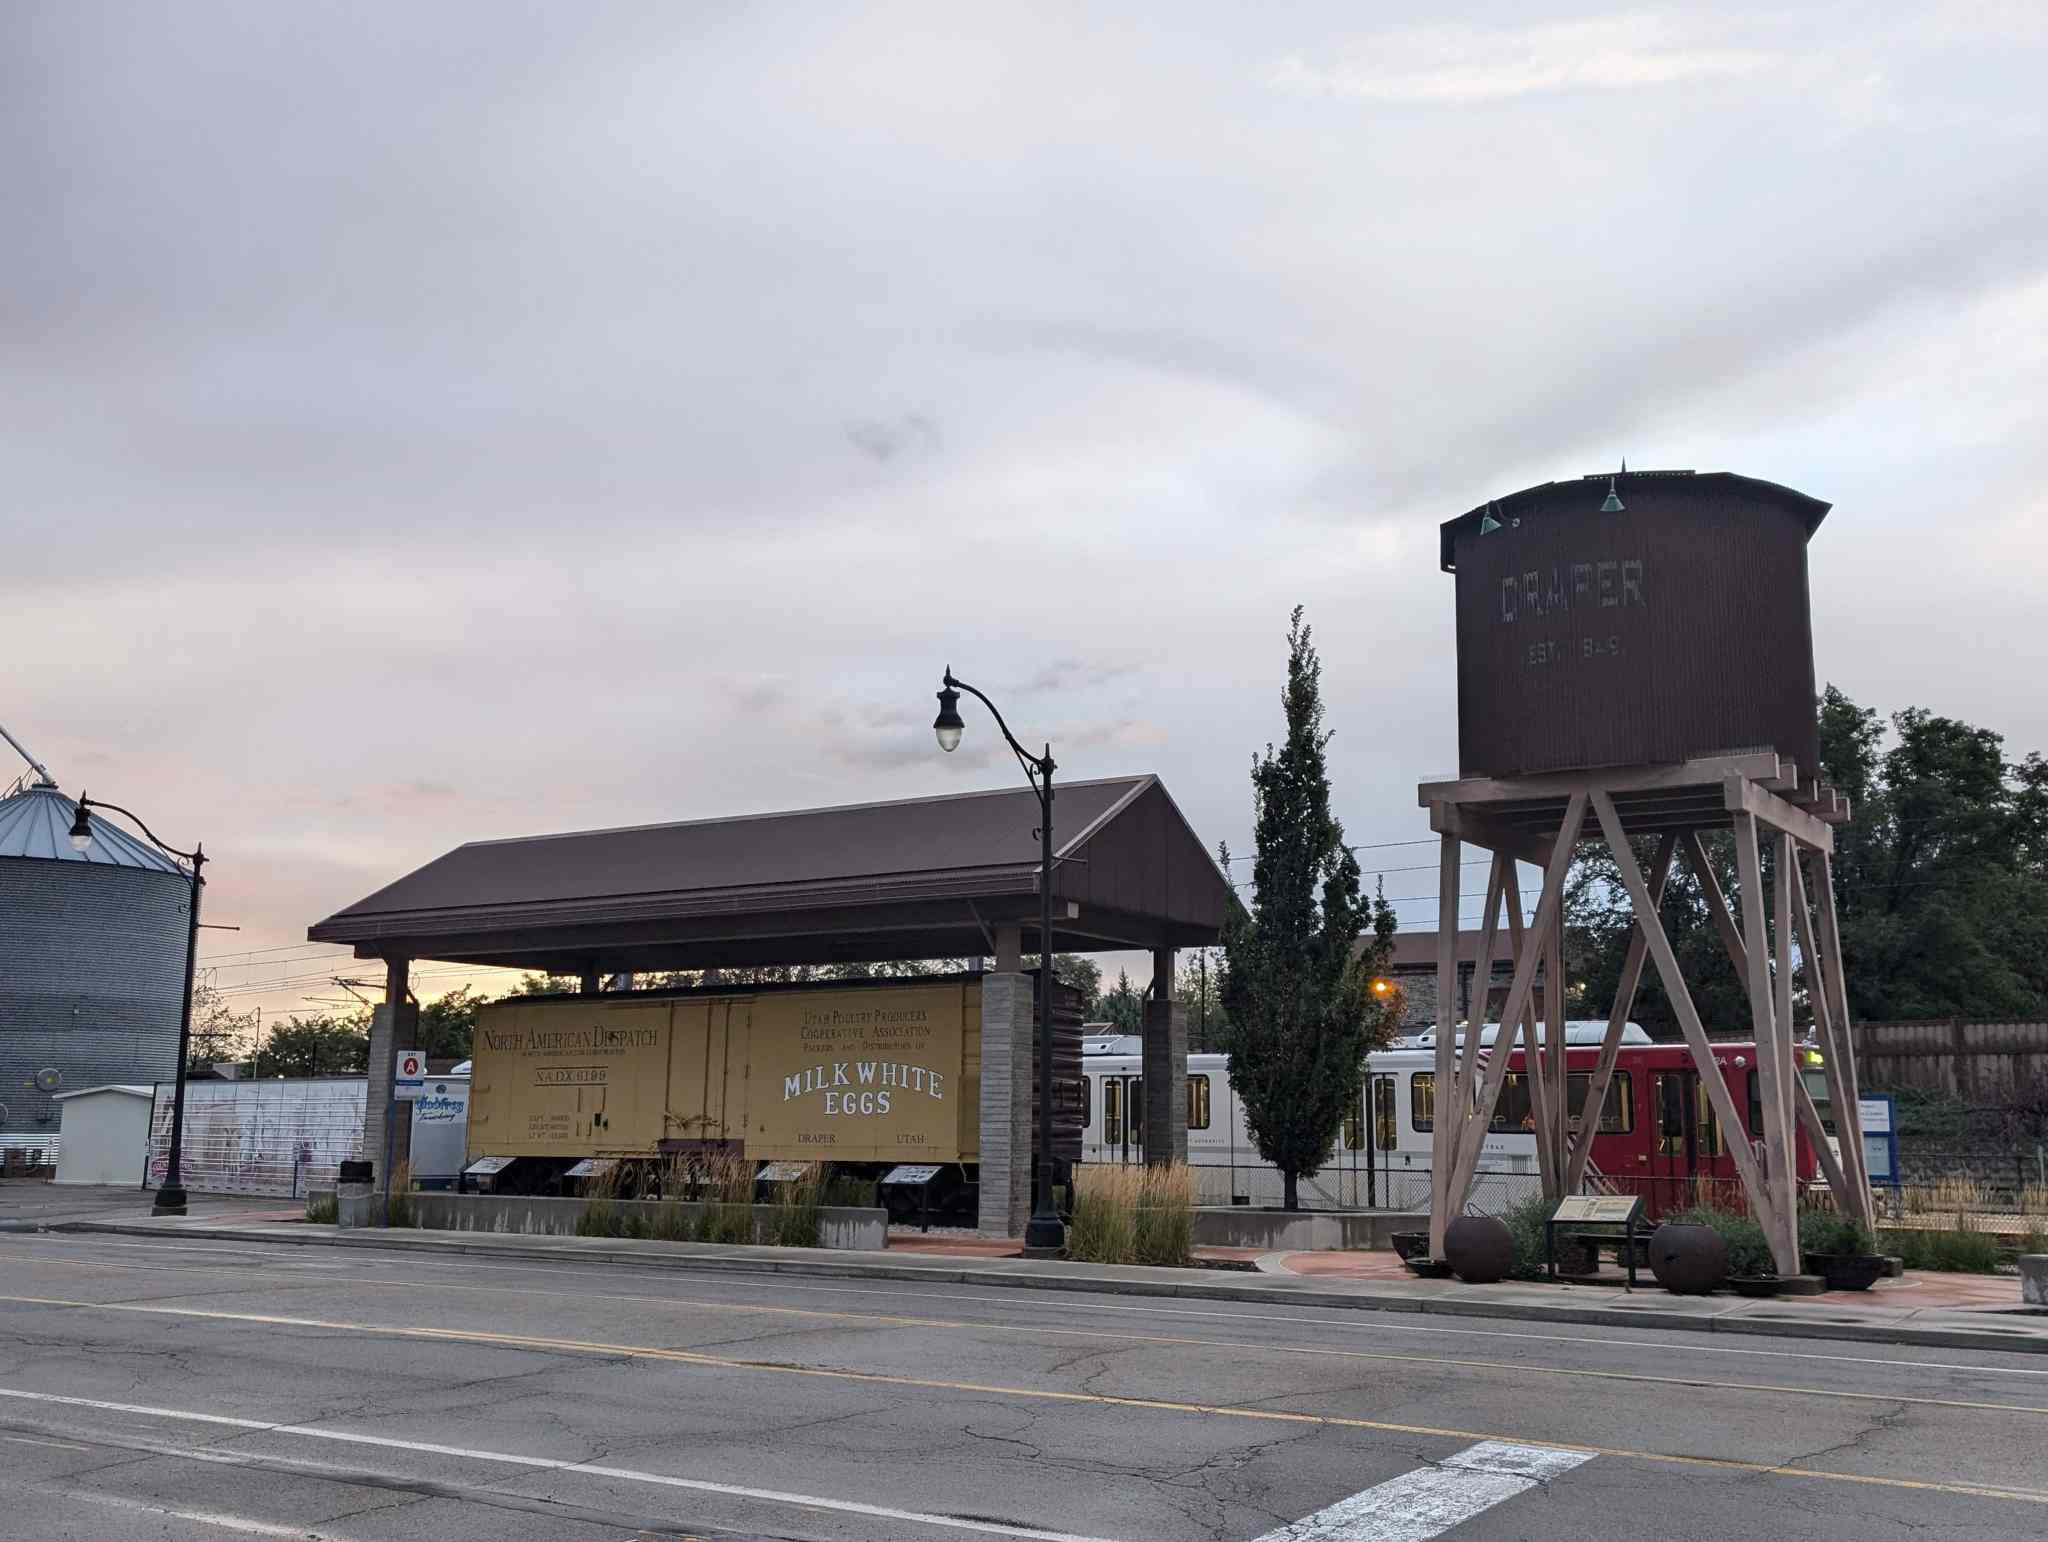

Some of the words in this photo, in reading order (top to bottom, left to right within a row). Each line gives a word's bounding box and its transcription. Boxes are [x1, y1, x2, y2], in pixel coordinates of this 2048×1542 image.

[484, 1029, 523, 1051] NORTH
[528, 1026, 592, 1049] AMERICAN
[406, 1061, 415, 1073] A
[784, 1063, 850, 1100] MILK
[856, 1062, 945, 1099] WHITE
[824, 1091, 891, 1115] EGGS
[799, 1133, 836, 1144] DRAPER
[897, 1135, 924, 1144] UTAH
